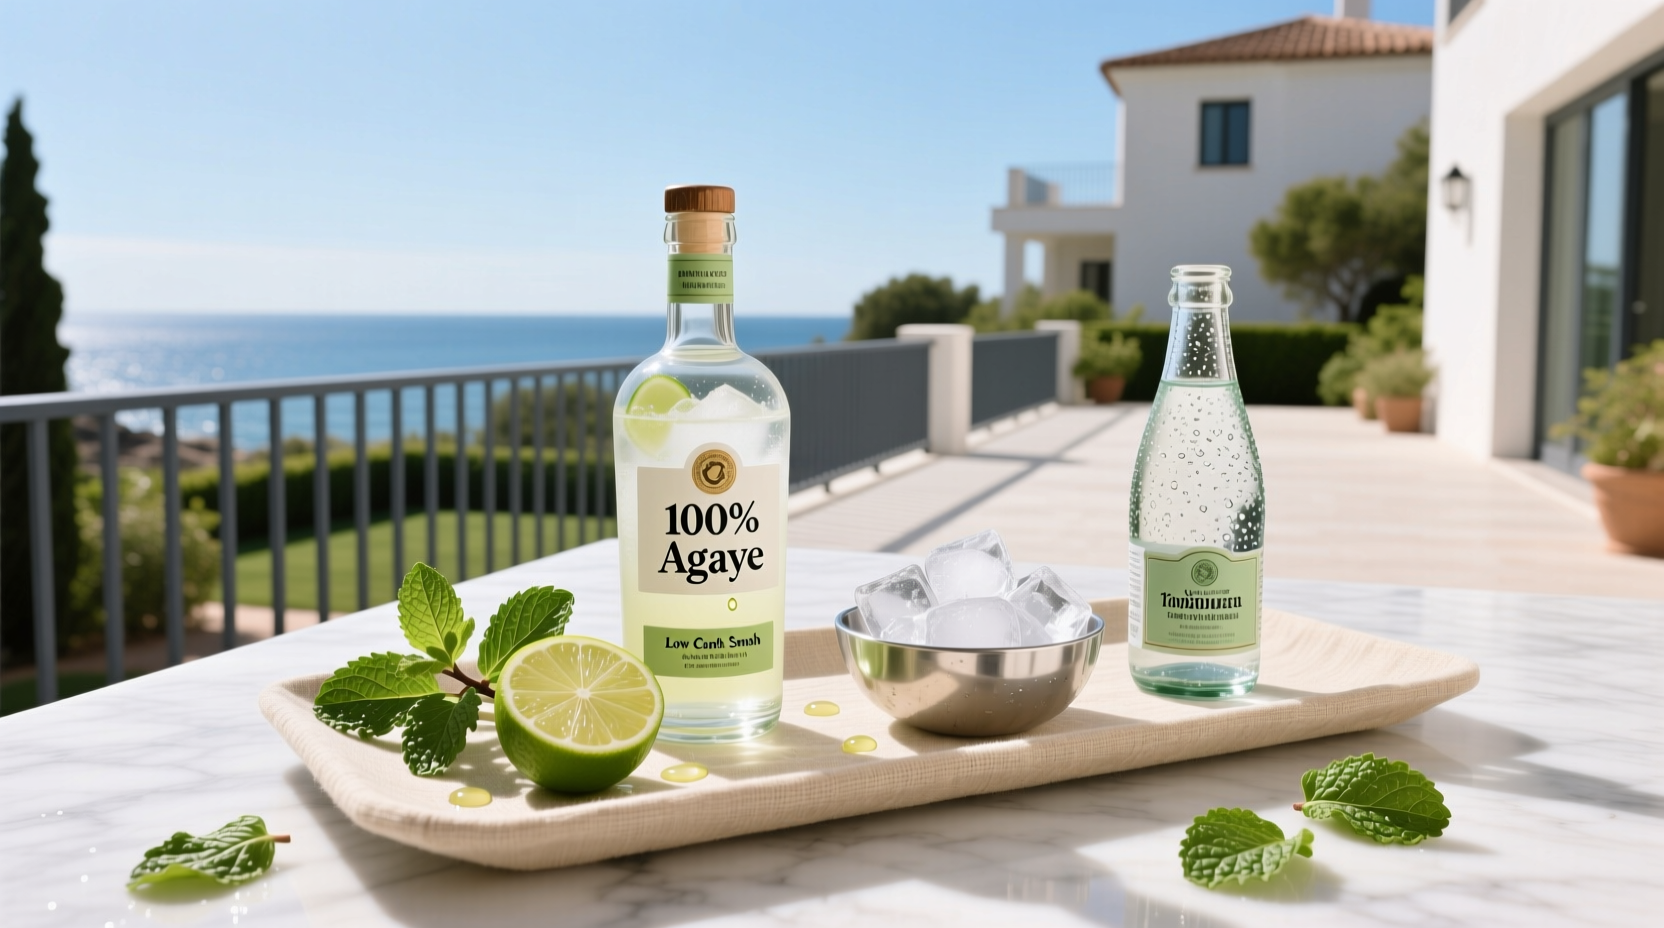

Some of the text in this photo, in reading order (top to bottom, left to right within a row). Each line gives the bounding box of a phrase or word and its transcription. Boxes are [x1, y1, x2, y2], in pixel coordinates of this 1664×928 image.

[665, 500, 759, 536] 100%
[658, 540, 764, 585] Agaye
[665, 636, 690, 649] Low
